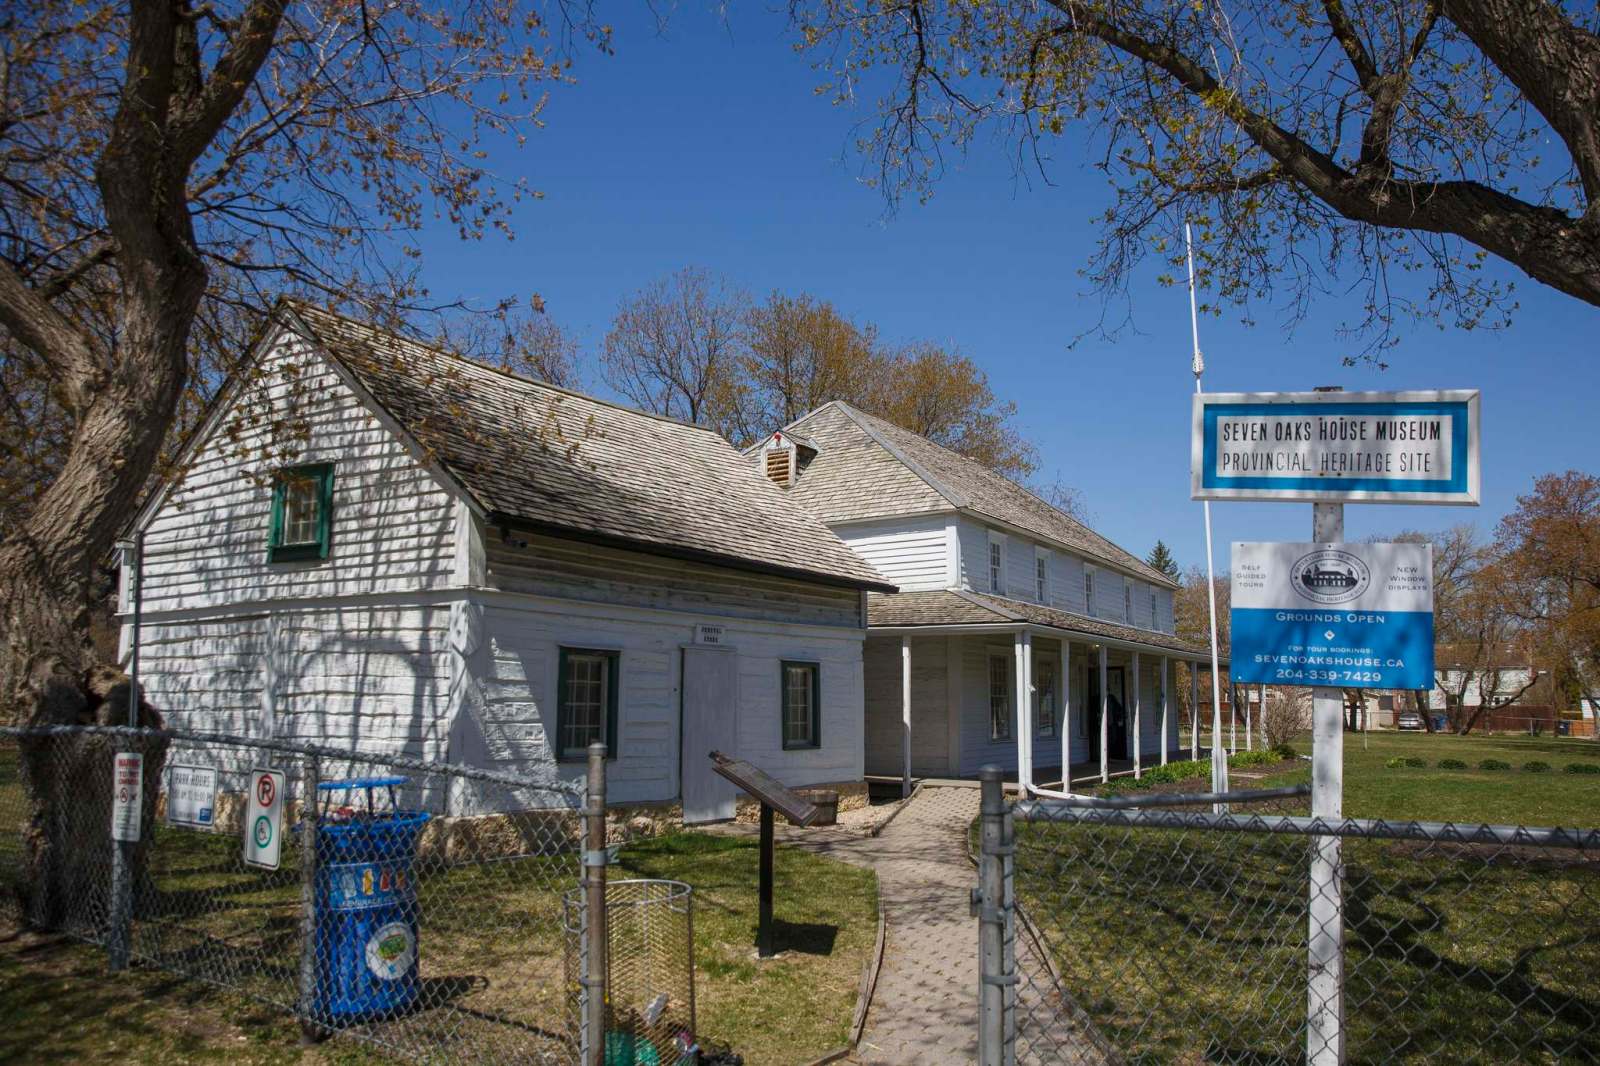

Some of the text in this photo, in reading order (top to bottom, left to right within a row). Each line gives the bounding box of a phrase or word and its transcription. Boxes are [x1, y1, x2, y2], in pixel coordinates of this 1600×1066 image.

[1223, 420, 1441, 441] SEVEN OAKS HOUSE MUSEUM
[1223, 452, 1431, 472] PROVINCIAL HERITAGE SITE
[1276, 611, 1385, 624] GROUNDS OPEN
[1254, 654, 1405, 668] SEVENOAKSHOUSE.CA
[1276, 668, 1382, 682] 204-339-7429
